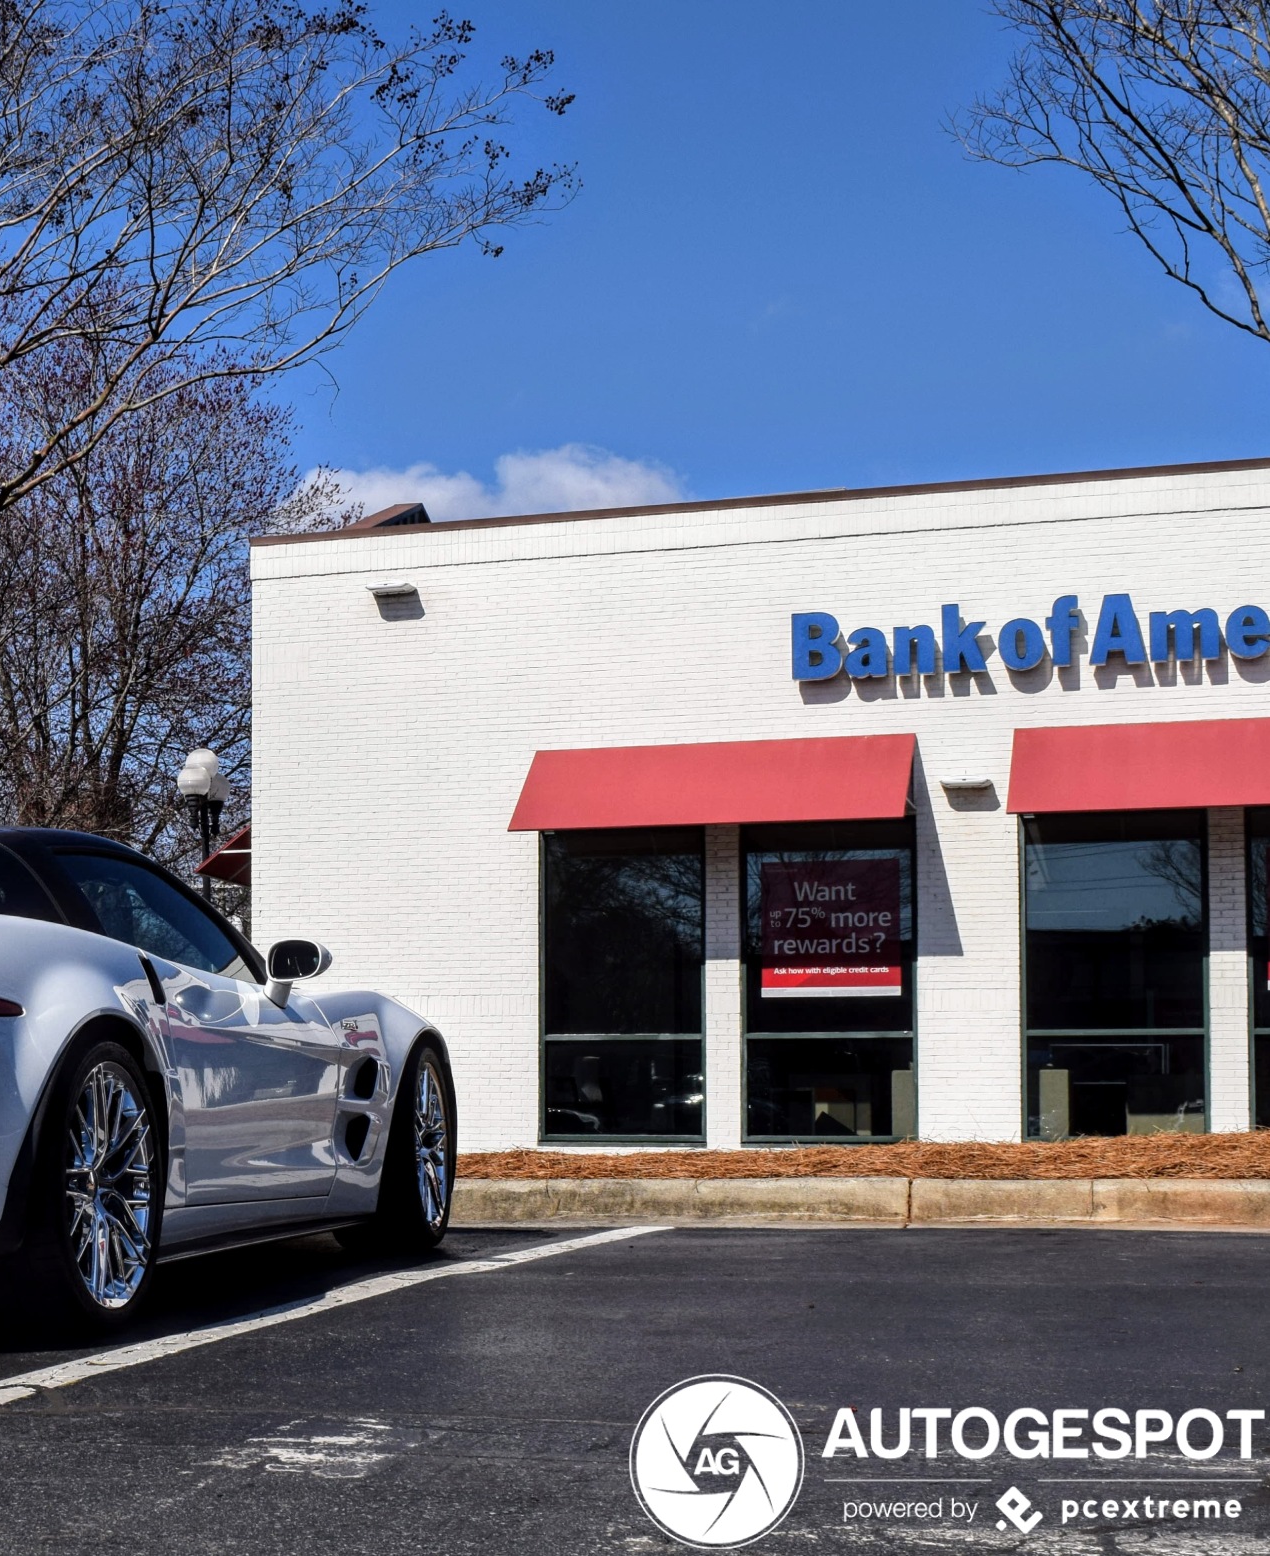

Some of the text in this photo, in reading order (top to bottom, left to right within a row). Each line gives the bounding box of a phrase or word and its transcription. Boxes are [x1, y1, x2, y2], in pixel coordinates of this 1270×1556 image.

[791, 604, 987, 681] Bank
[998, 595, 1079, 672] of
[793, 881, 857, 901] Want
[769, 910, 782, 919] up
[784, 907, 892, 928] 75% more
[770, 919, 781, 928] to
[805, 966, 821, 974] with
[822, 966, 847, 975] eligible
[848, 966, 868, 974] credit
[870, 966, 889, 974] cards
